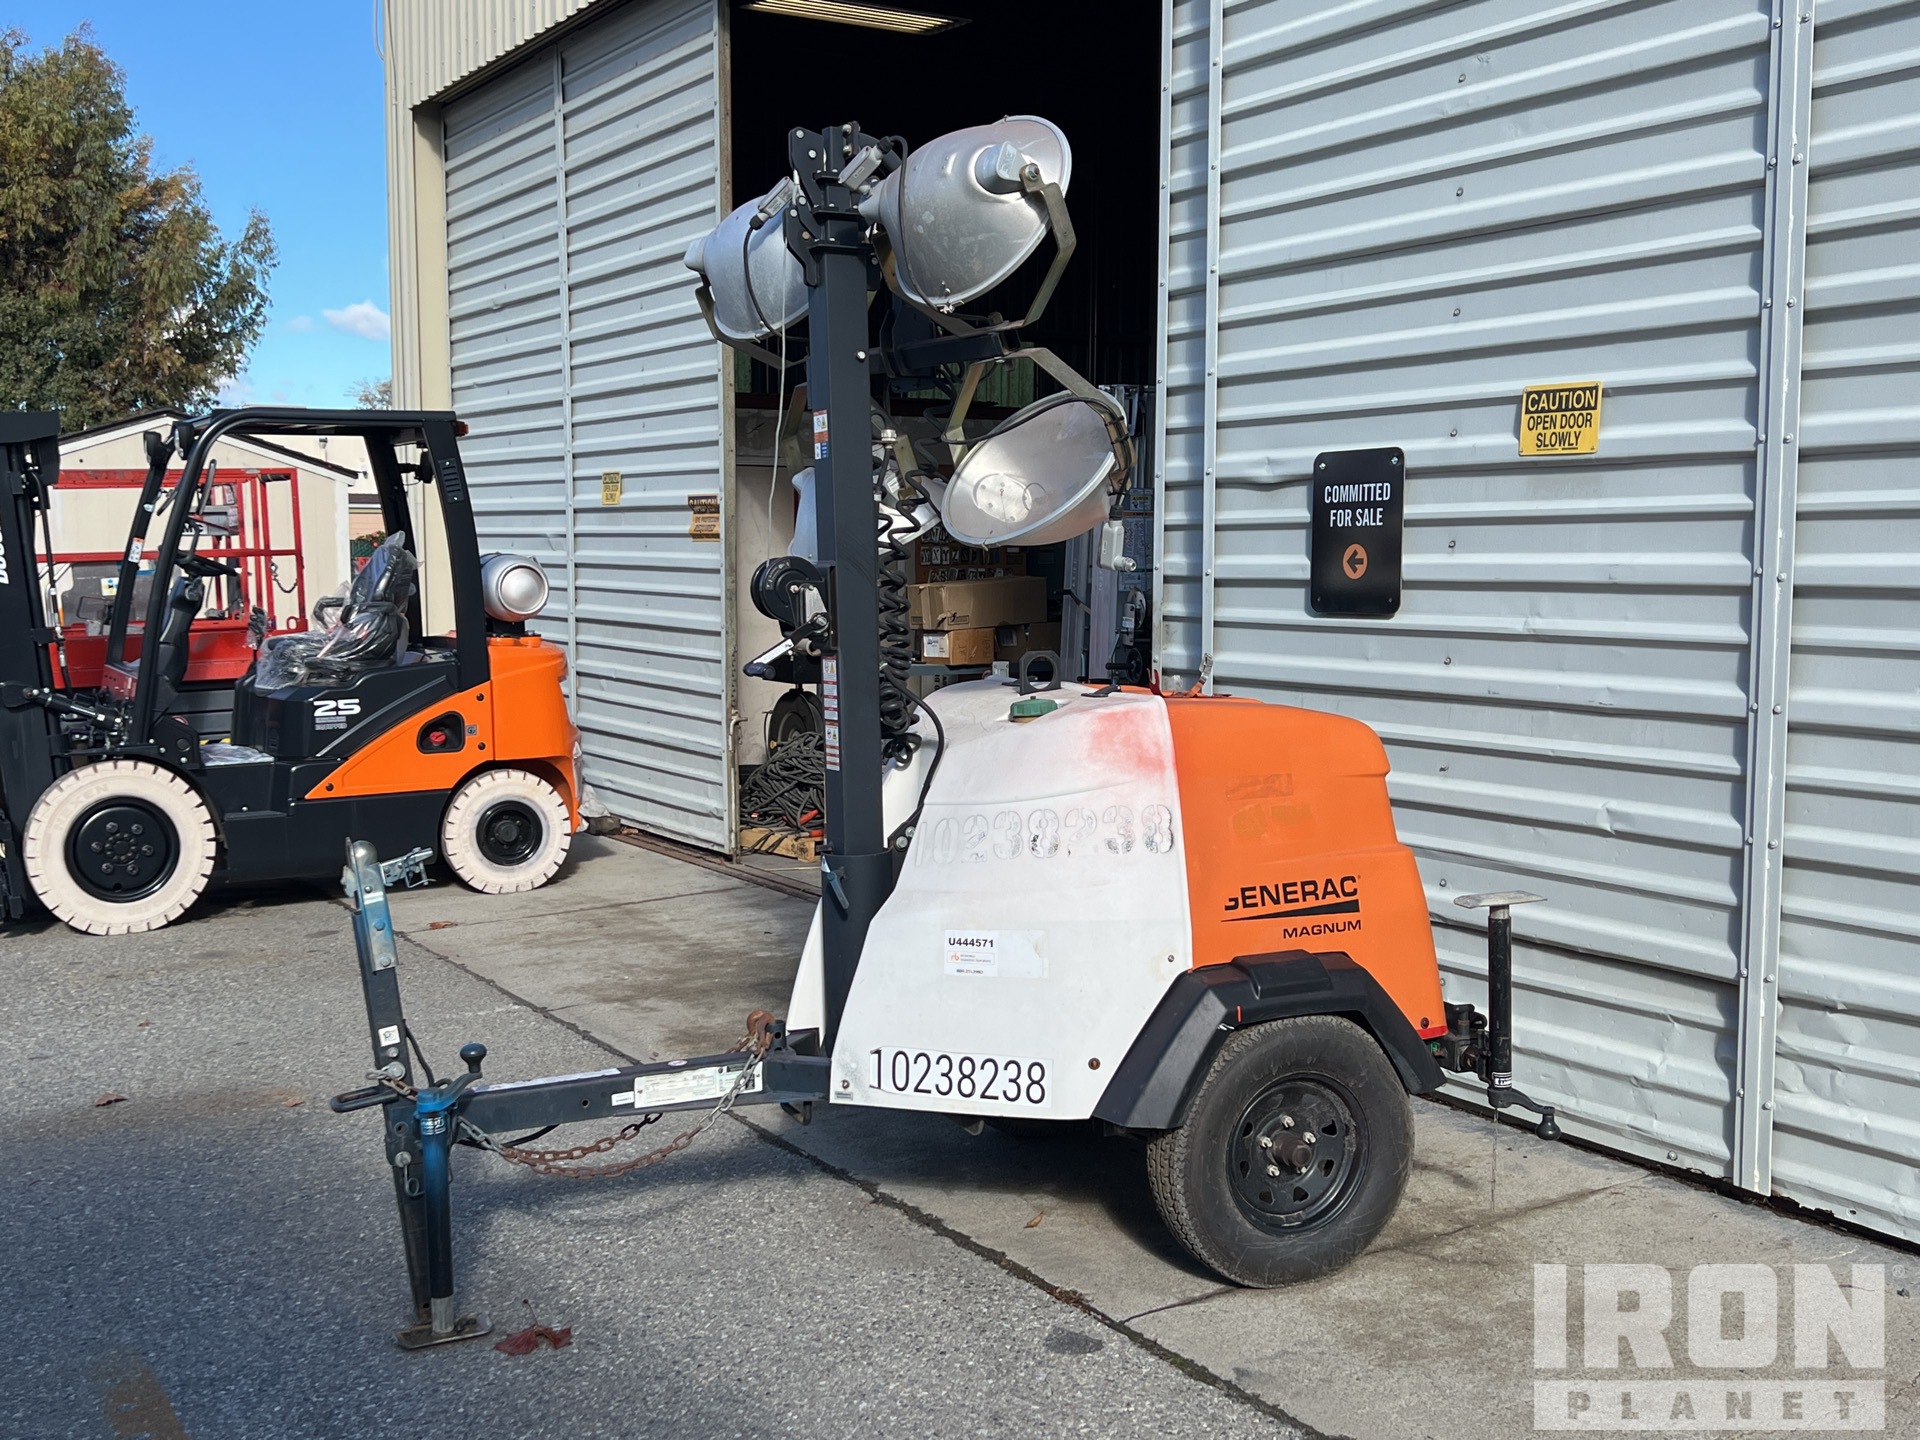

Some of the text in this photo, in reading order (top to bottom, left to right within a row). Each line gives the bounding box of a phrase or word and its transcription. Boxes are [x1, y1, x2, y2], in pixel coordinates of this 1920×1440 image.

[1527, 389, 1596, 411] CAUTION
[1527, 412, 1593, 431] OPEN DOOR
[1535, 430, 1582, 448] SLOWLY
[1324, 482, 1391, 504] COMMITTED
[1329, 507, 1384, 528] FOR SALE
[313, 698, 361, 716] 25
[1283, 919, 1361, 939] MAGNUM
[948, 937, 994, 948] U444571
[869, 1049, 1046, 1105] 10238238
